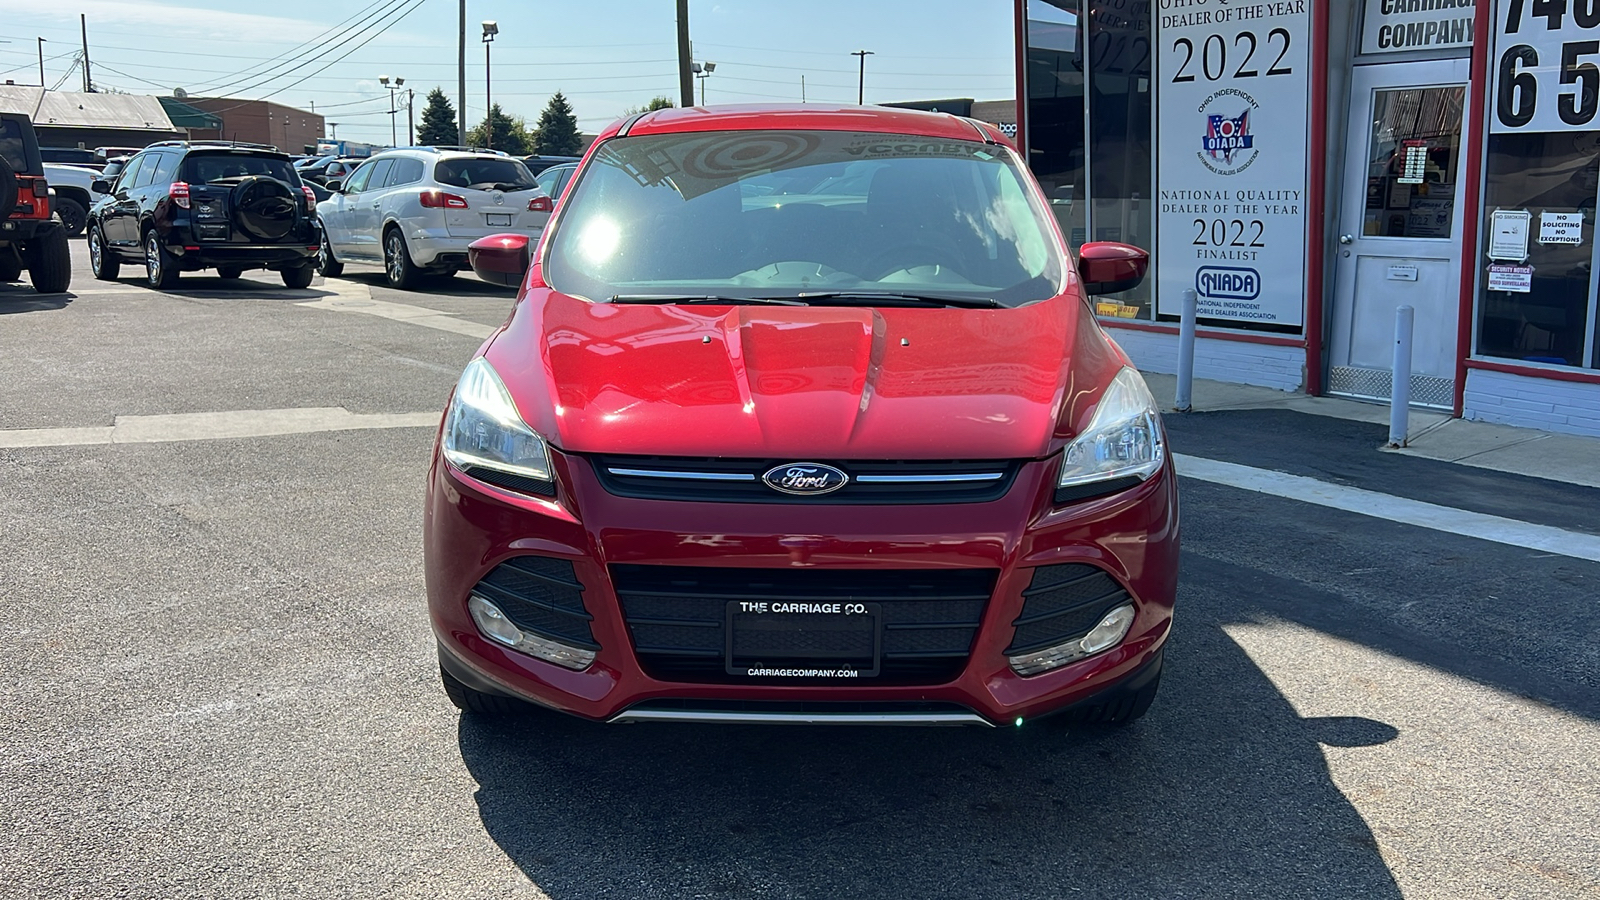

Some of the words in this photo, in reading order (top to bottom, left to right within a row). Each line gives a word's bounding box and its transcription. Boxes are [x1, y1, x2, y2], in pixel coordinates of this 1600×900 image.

[1162, 11, 1212, 29] DEALER
[1215, 8, 1232, 23] OF
[1235, 5, 1264, 20] THE
[1266, 0, 1306, 17] YEAR
[1378, 17, 1476, 49] COMPANY
[1171, 27, 1293, 83] 2022
[1198, 95, 1213, 113] OHIO
[1214, 88, 1260, 110] INDEPENDENT
[1208, 136, 1245, 149] OIADA
[1197, 151, 1218, 174] AUTOMOBILE
[1217, 168, 1236, 176] DEALERS
[1236, 149, 1260, 174] ASSOCIATION
[1161, 190, 1230, 200] NATIONAL
[1236, 190, 1301, 202] QUALITY
[1162, 204, 1208, 214] DEALER
[1213, 204, 1229, 214] OF
[1234, 204, 1259, 214] THE
[1264, 205, 1298, 215] YEAR
[1192, 218, 1265, 248] 2022
[1196, 249, 1258, 261] FINALIST
[1201, 272, 1254, 293] NIADA
[1215, 309, 1237, 317] DEALERS
[1238, 311, 1277, 319] ASSOCIATION
[1223, 302, 1260, 310] INDEPENDENT
[782, 467, 829, 488] Ford
[740, 602, 768, 613] THE
[772, 603, 841, 614] CARRIAGE
[845, 603, 868, 614] CO.
[747, 668, 858, 678] CARRIAGECOMPANY.COM
